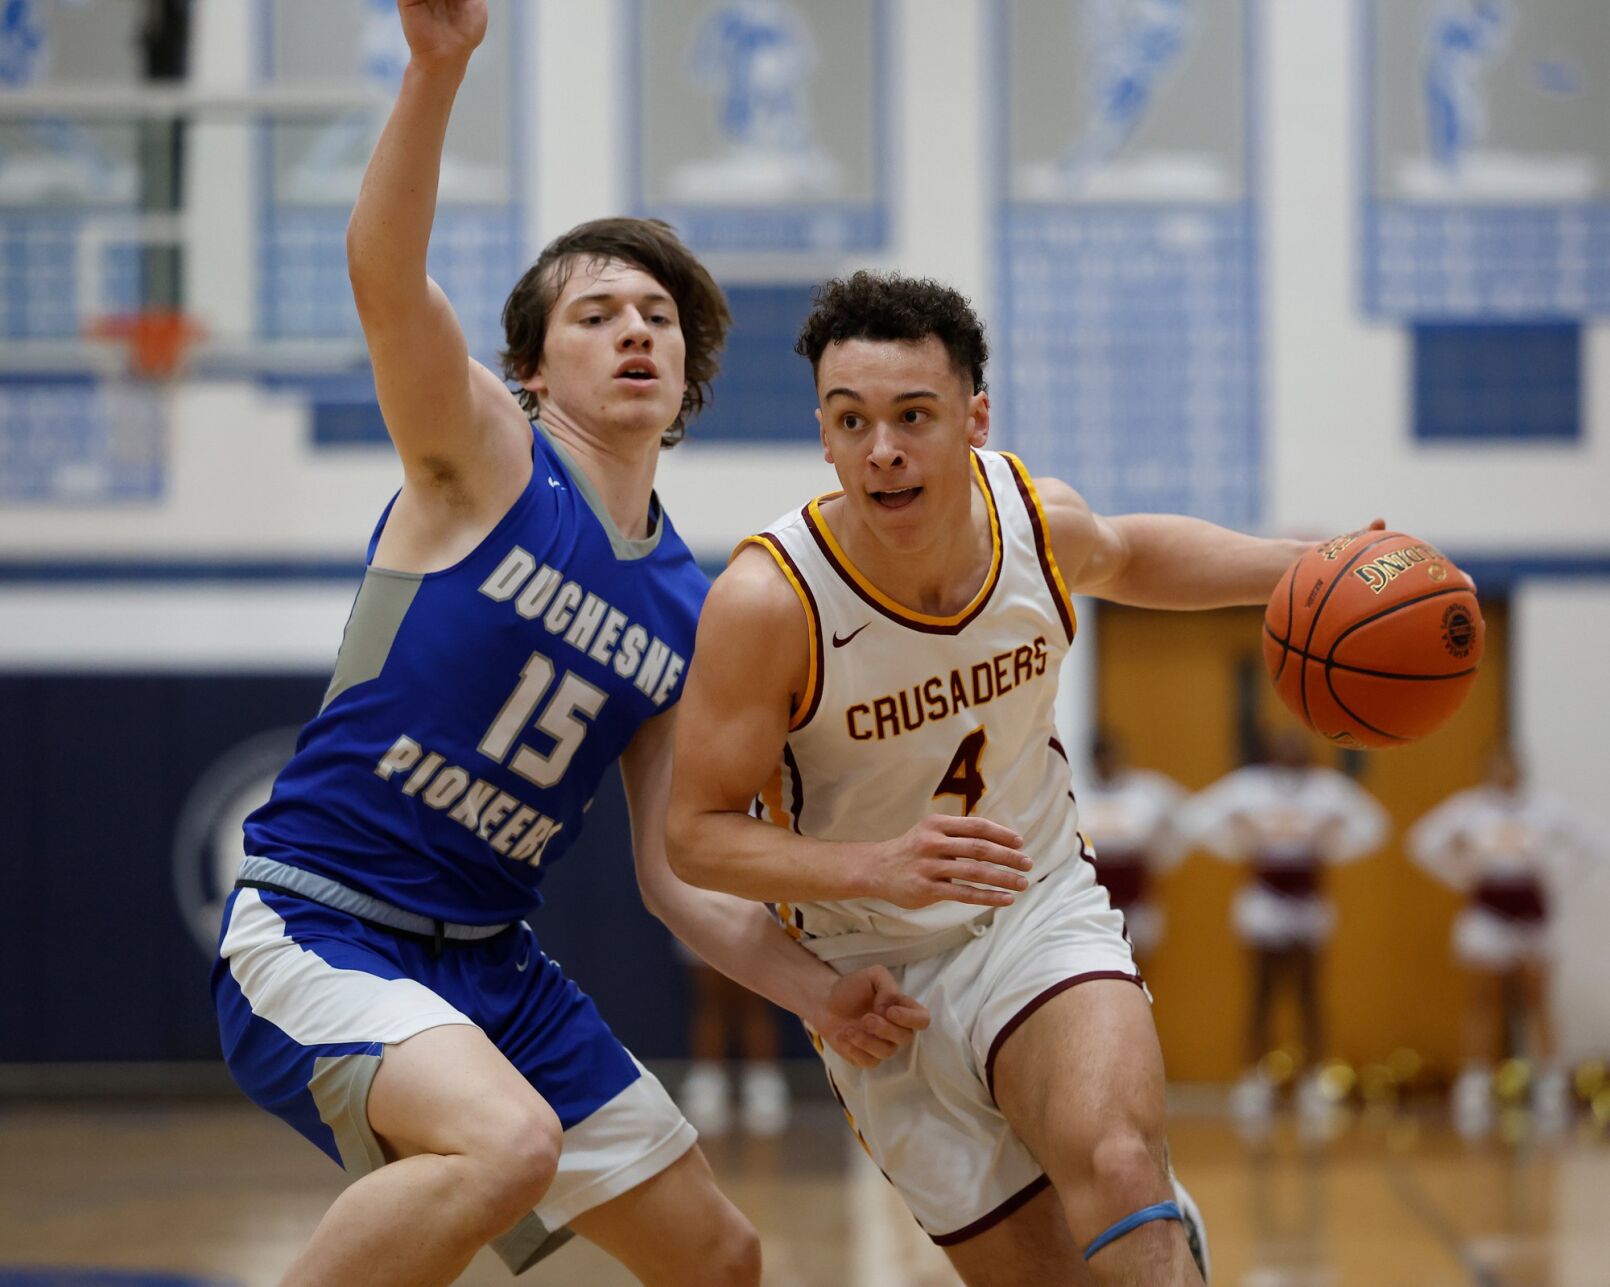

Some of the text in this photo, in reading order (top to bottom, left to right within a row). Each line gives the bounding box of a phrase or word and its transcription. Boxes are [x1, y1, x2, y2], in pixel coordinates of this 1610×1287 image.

[477, 544, 686, 707] DUCHESNE
[476, 649, 610, 790] 15
[845, 636, 1049, 742] CRUSADERS
[931, 723, 989, 818] 4
